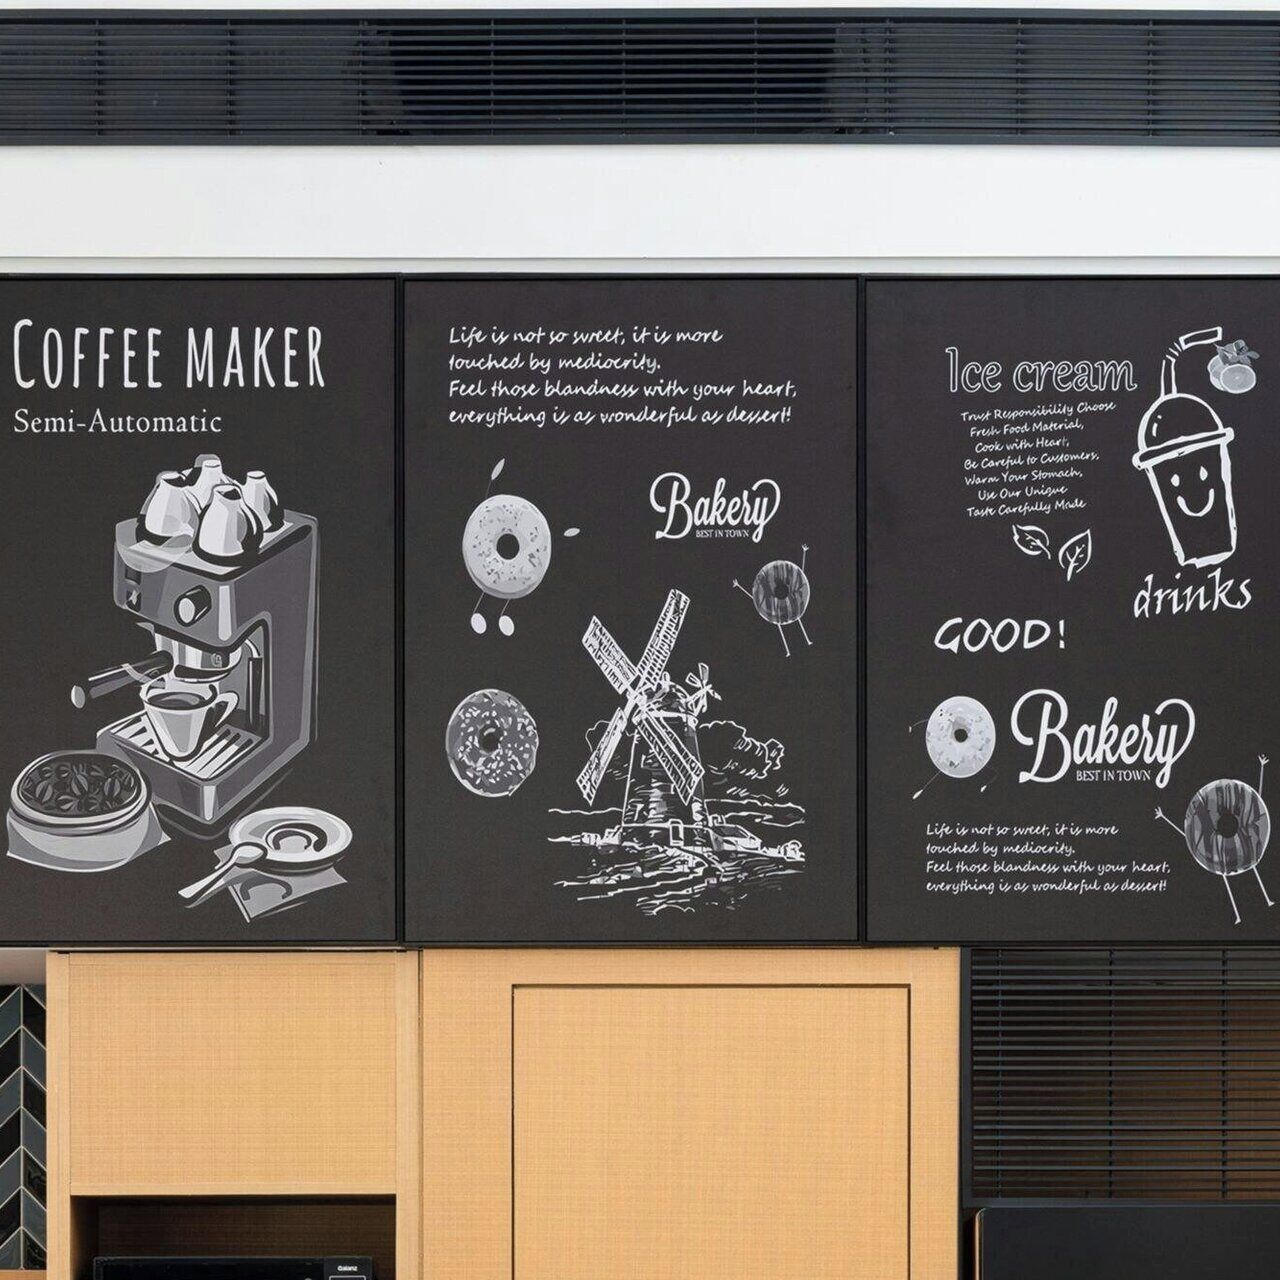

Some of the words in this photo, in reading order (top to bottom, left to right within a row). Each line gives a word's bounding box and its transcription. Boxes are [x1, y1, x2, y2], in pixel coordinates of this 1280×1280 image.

[450, 327, 487, 348] Life
[492, 326, 509, 345] is
[514, 327, 546, 343] not
[549, 331, 568, 344] so
[573, 328, 625, 345] sweet,
[633, 326, 650, 343] it
[654, 326, 672, 344] is
[676, 330, 723, 342] more
[14, 319, 162, 388] COFFEE
[187, 326, 324, 388] MAKER
[449, 353, 525, 370] touched
[530, 353, 550, 374] by
[559, 352, 660, 374] mediocrity.
[945, 347, 1002, 392] Ice
[1013, 360, 1138, 392] cream
[450, 380, 487, 397] Feel
[491, 380, 540, 398] those
[544, 379, 639, 398] blandness
[644, 379, 689, 396] with
[693, 385, 735, 400] your
[743, 380, 796, 397] heart,
[14, 408, 221, 432] Semi-Automatic
[449, 406, 545, 428] everything
[553, 406, 570, 424] is
[574, 411, 596, 424] as
[600, 406, 697, 427] wonderful
[702, 411, 724, 424] as
[726, 406, 791, 424] dessert!
[961, 411, 991, 421] Trust
[994, 404, 1073, 420] Responsibility
[1077, 402, 1116, 413] Choose
[970, 426, 1001, 436] Fresh
[1004, 423, 1030, 434] Food
[1032, 418, 1084, 432] Material,
[975, 442, 1004, 453] Cook
[1006, 439, 1034, 450] with
[1036, 437, 1069, 448] Heart,
[964, 459, 978, 470] Be
[981, 455, 1024, 469] Careful
[1027, 456, 1038, 465] to
[1040, 452, 1099, 464] Customers,
[965, 474, 999, 485] Warm
[1002, 471, 1028, 482] Your
[1031, 467, 1082, 480] Stomach,
[978, 490, 998, 500] Use
[1000, 488, 1021, 499] Our
[1025, 485, 1068, 497] Unique
[650, 472, 780, 543] Bakery
[967, 507, 996, 517] Taste
[998, 502, 1050, 515] Carefully
[1055, 498, 1086, 510] Made
[1134, 568, 1251, 618] drinks
[934, 617, 1064, 654] GOOD!
[1010, 688, 1196, 789] Bakery
[1077, 770, 1100, 781] BEST
[1104, 770, 1114, 781] IN
[1117, 770, 1150, 781] TOWN
